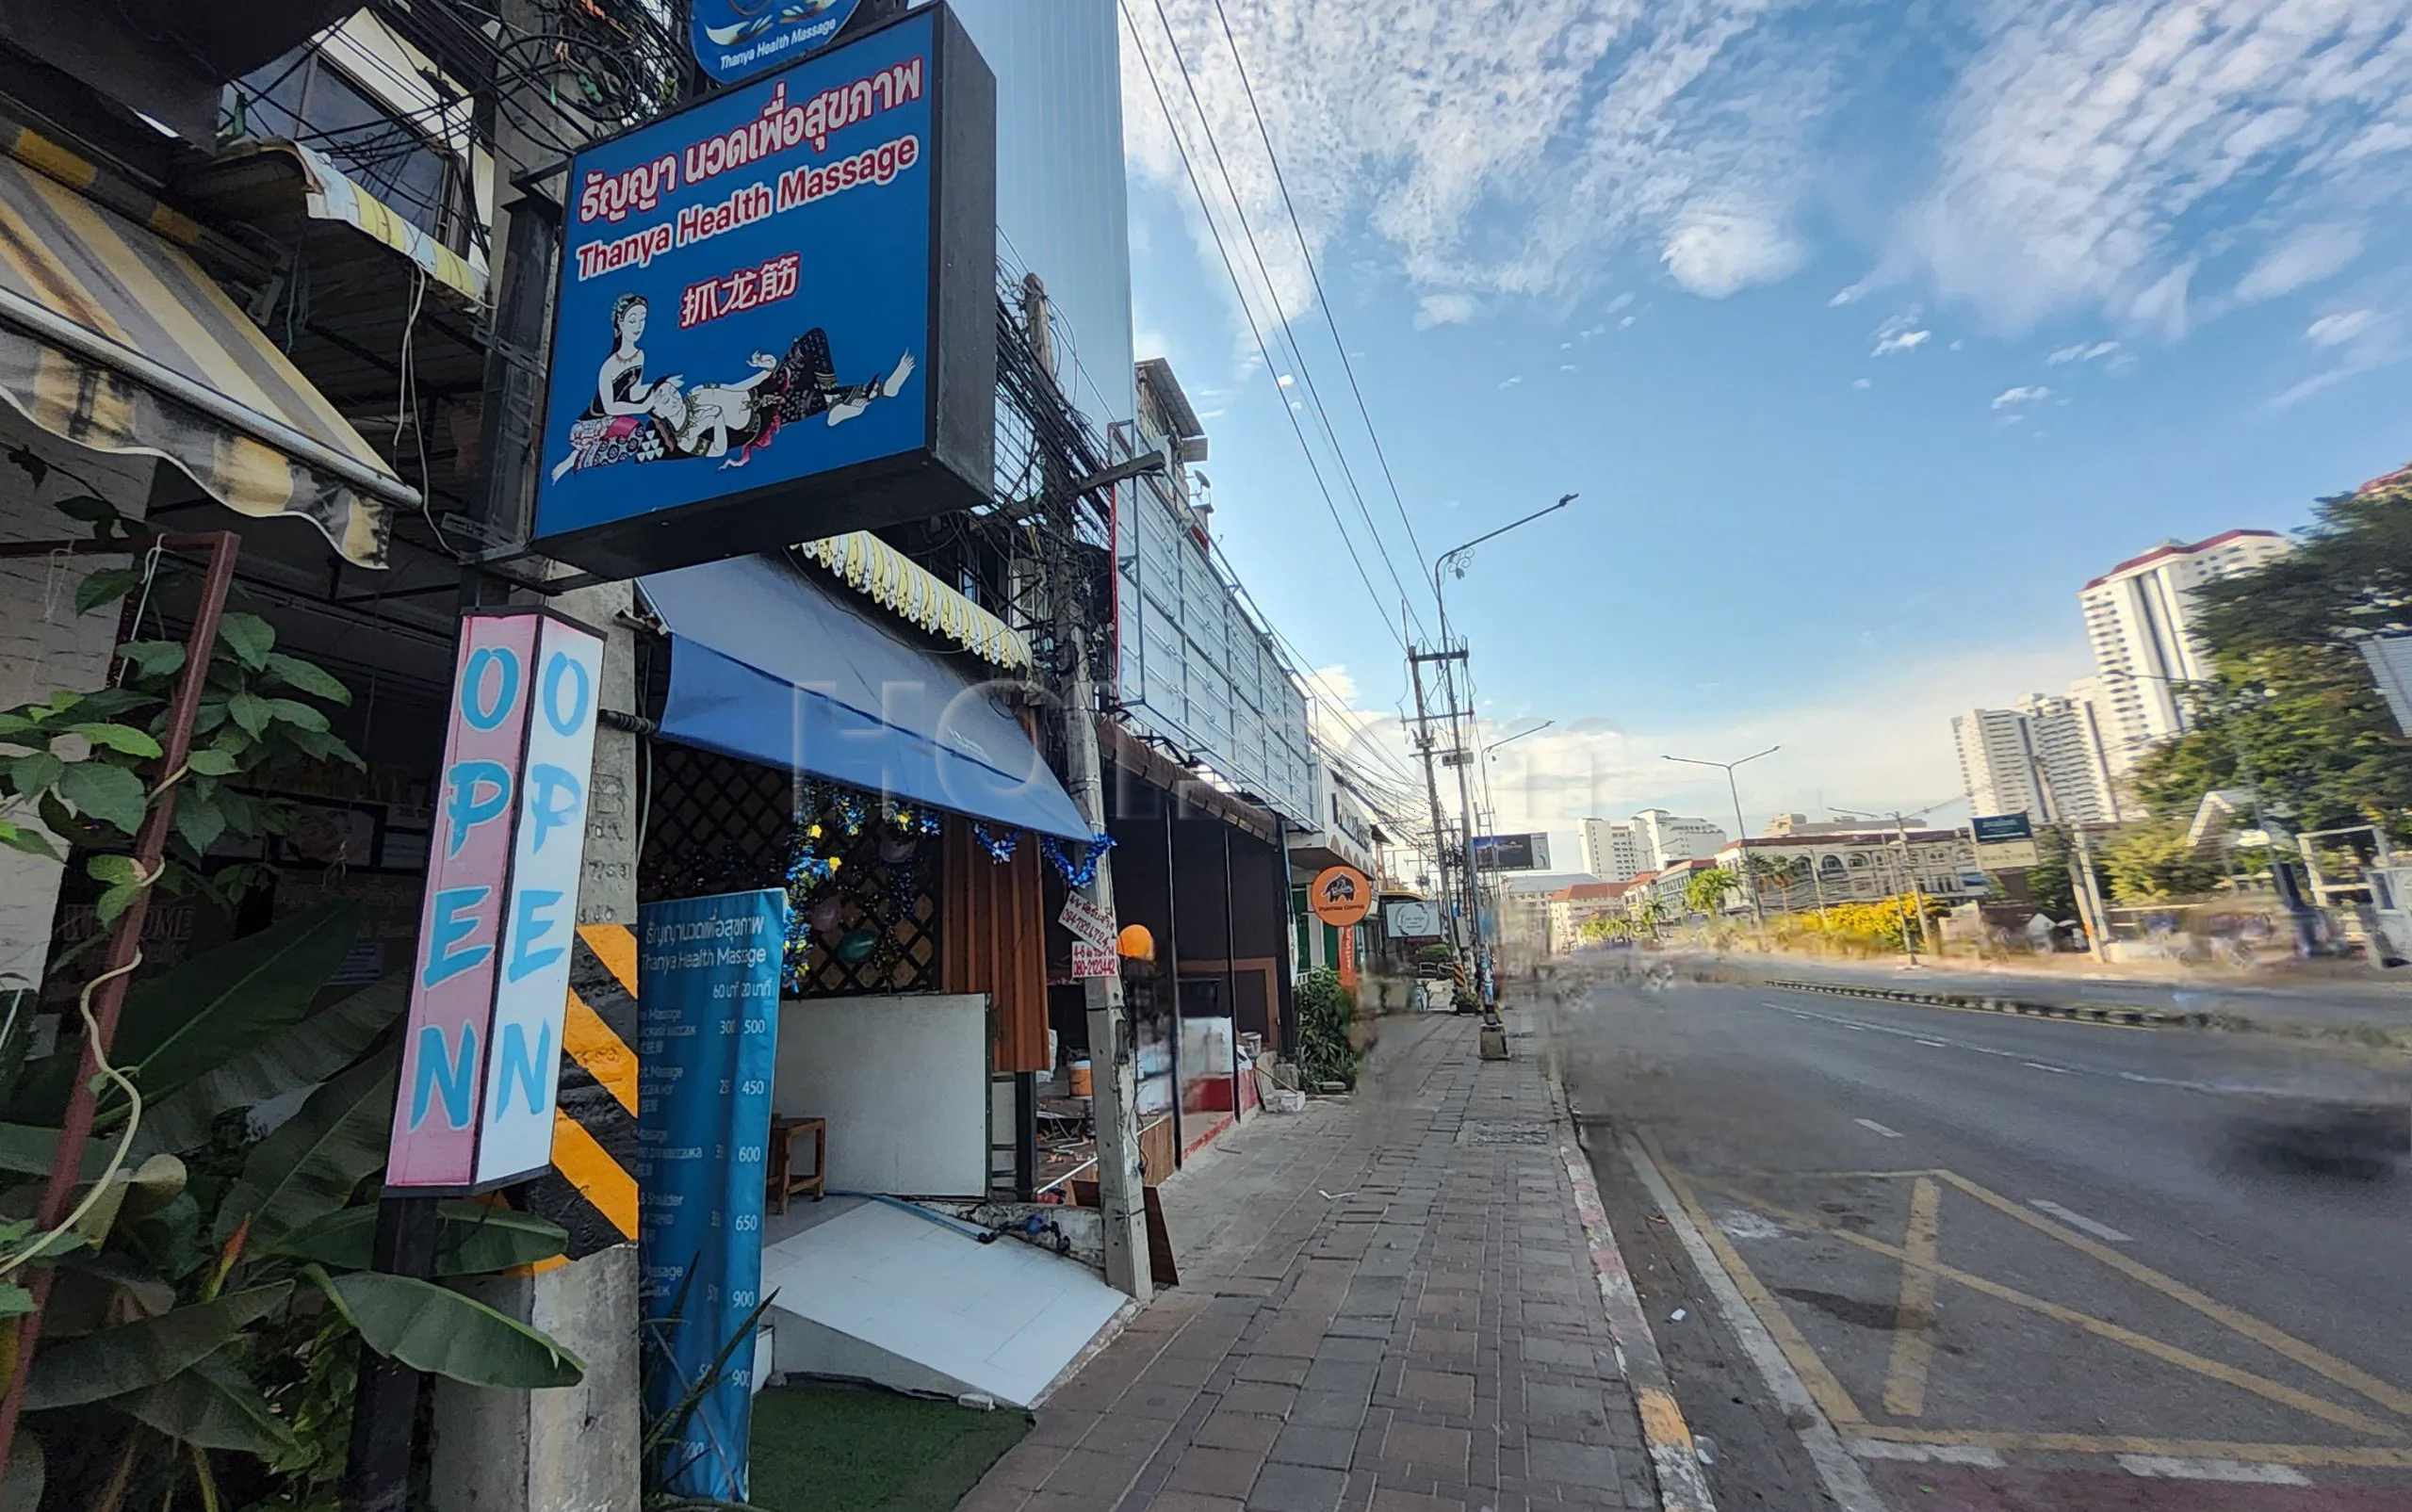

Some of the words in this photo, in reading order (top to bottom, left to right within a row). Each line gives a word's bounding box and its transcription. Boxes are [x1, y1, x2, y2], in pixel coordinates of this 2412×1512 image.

[720, 48, 755, 71] Thanya
[757, 34, 790, 58] Health
[791, 18, 837, 45] Massage
[579, 153, 677, 223] ธัญญา
[684, 57, 922, 185] นวดเพื่อสุขภาพ
[577, 224, 671, 281] Thanya
[677, 185, 772, 247] Health
[777, 135, 920, 215] Massage
[679, 252, 801, 328] 抓龙筋
[409, 646, 520, 1131] OPEN
[495, 651, 591, 1124] OPEN
[716, 946, 767, 968] Massge
[743, 1018, 766, 1034] 500
[742, 1080, 765, 1095] 450
[738, 1146, 761, 1162] 600
[735, 1214, 758, 1231] 650
[732, 1290, 755, 1308] 900
